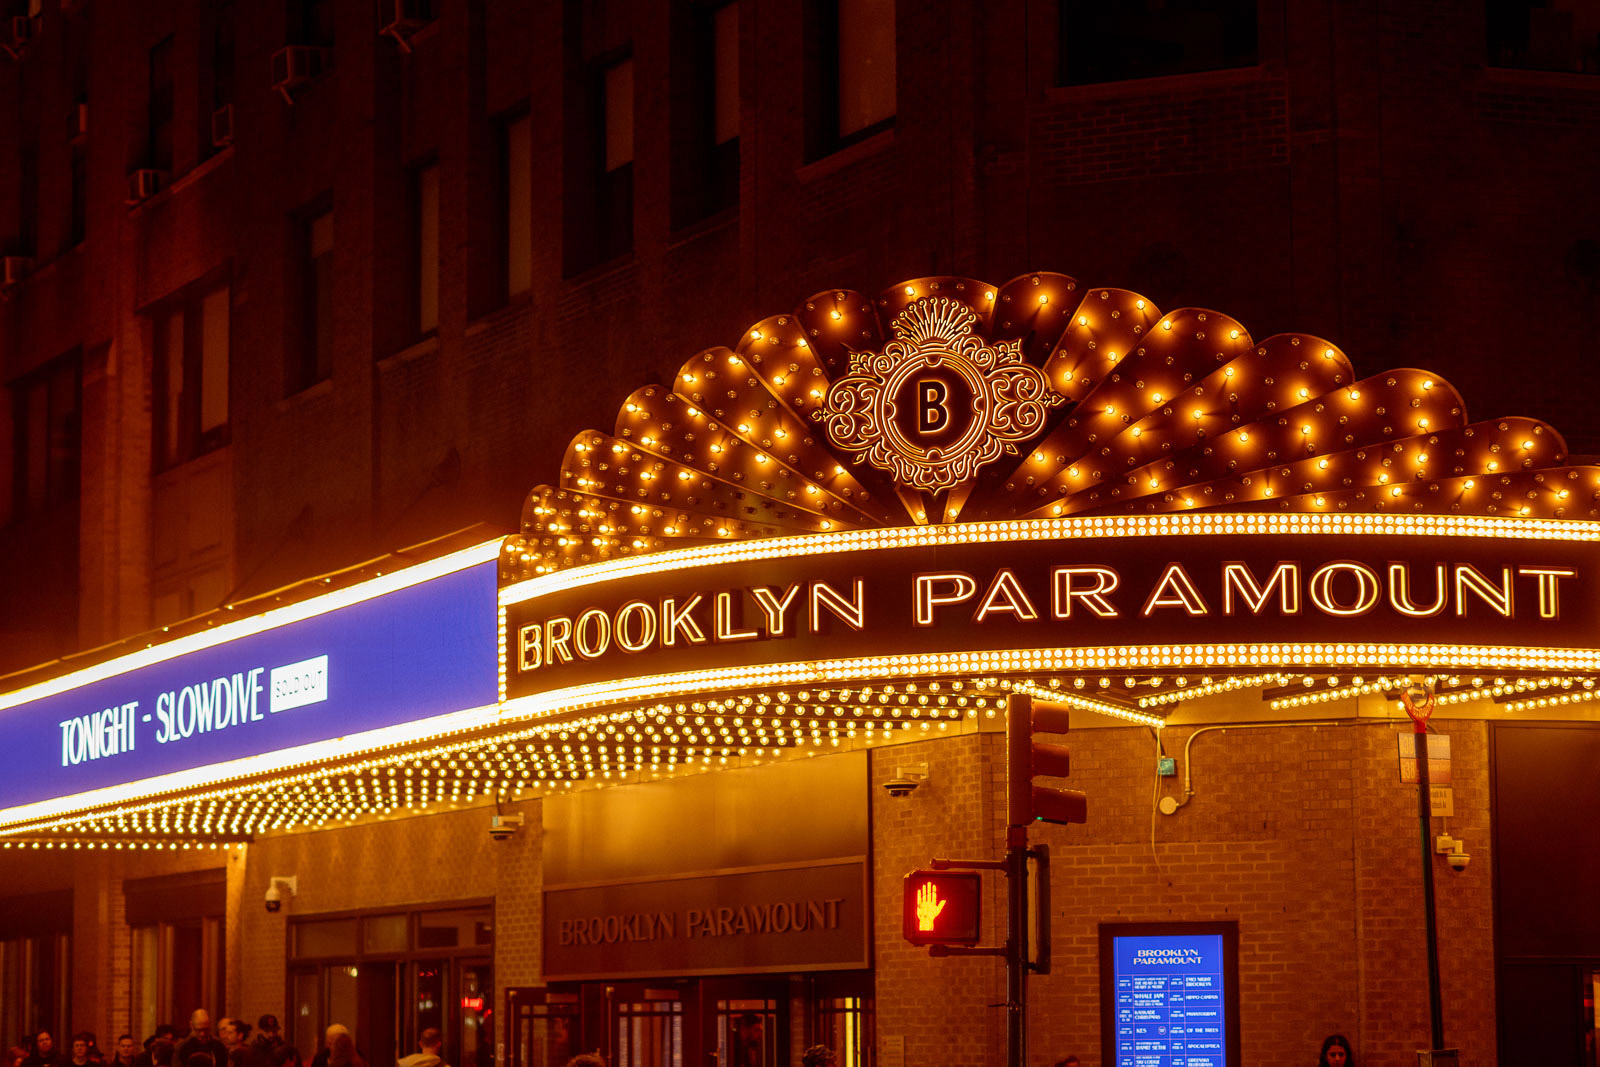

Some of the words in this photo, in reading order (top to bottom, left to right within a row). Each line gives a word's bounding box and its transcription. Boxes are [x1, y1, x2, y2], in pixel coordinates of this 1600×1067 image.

[918, 380, 950, 433] B
[517, 576, 865, 673] BROOKLYN
[912, 560, 1577, 627] PARAMOUNT
[275, 676, 300, 698] SOLD
[303, 670, 322, 690] OUT
[59, 700, 139, 768] TONIGHT
[155, 666, 265, 744] SLOWDIVE
[559, 911, 676, 946] BROOKLYN
[686, 898, 845, 938] PARAMOUNT
[1133, 956, 1203, 965] PARAMOUNT
[1137, 949, 1199, 957] BROOKLYN
